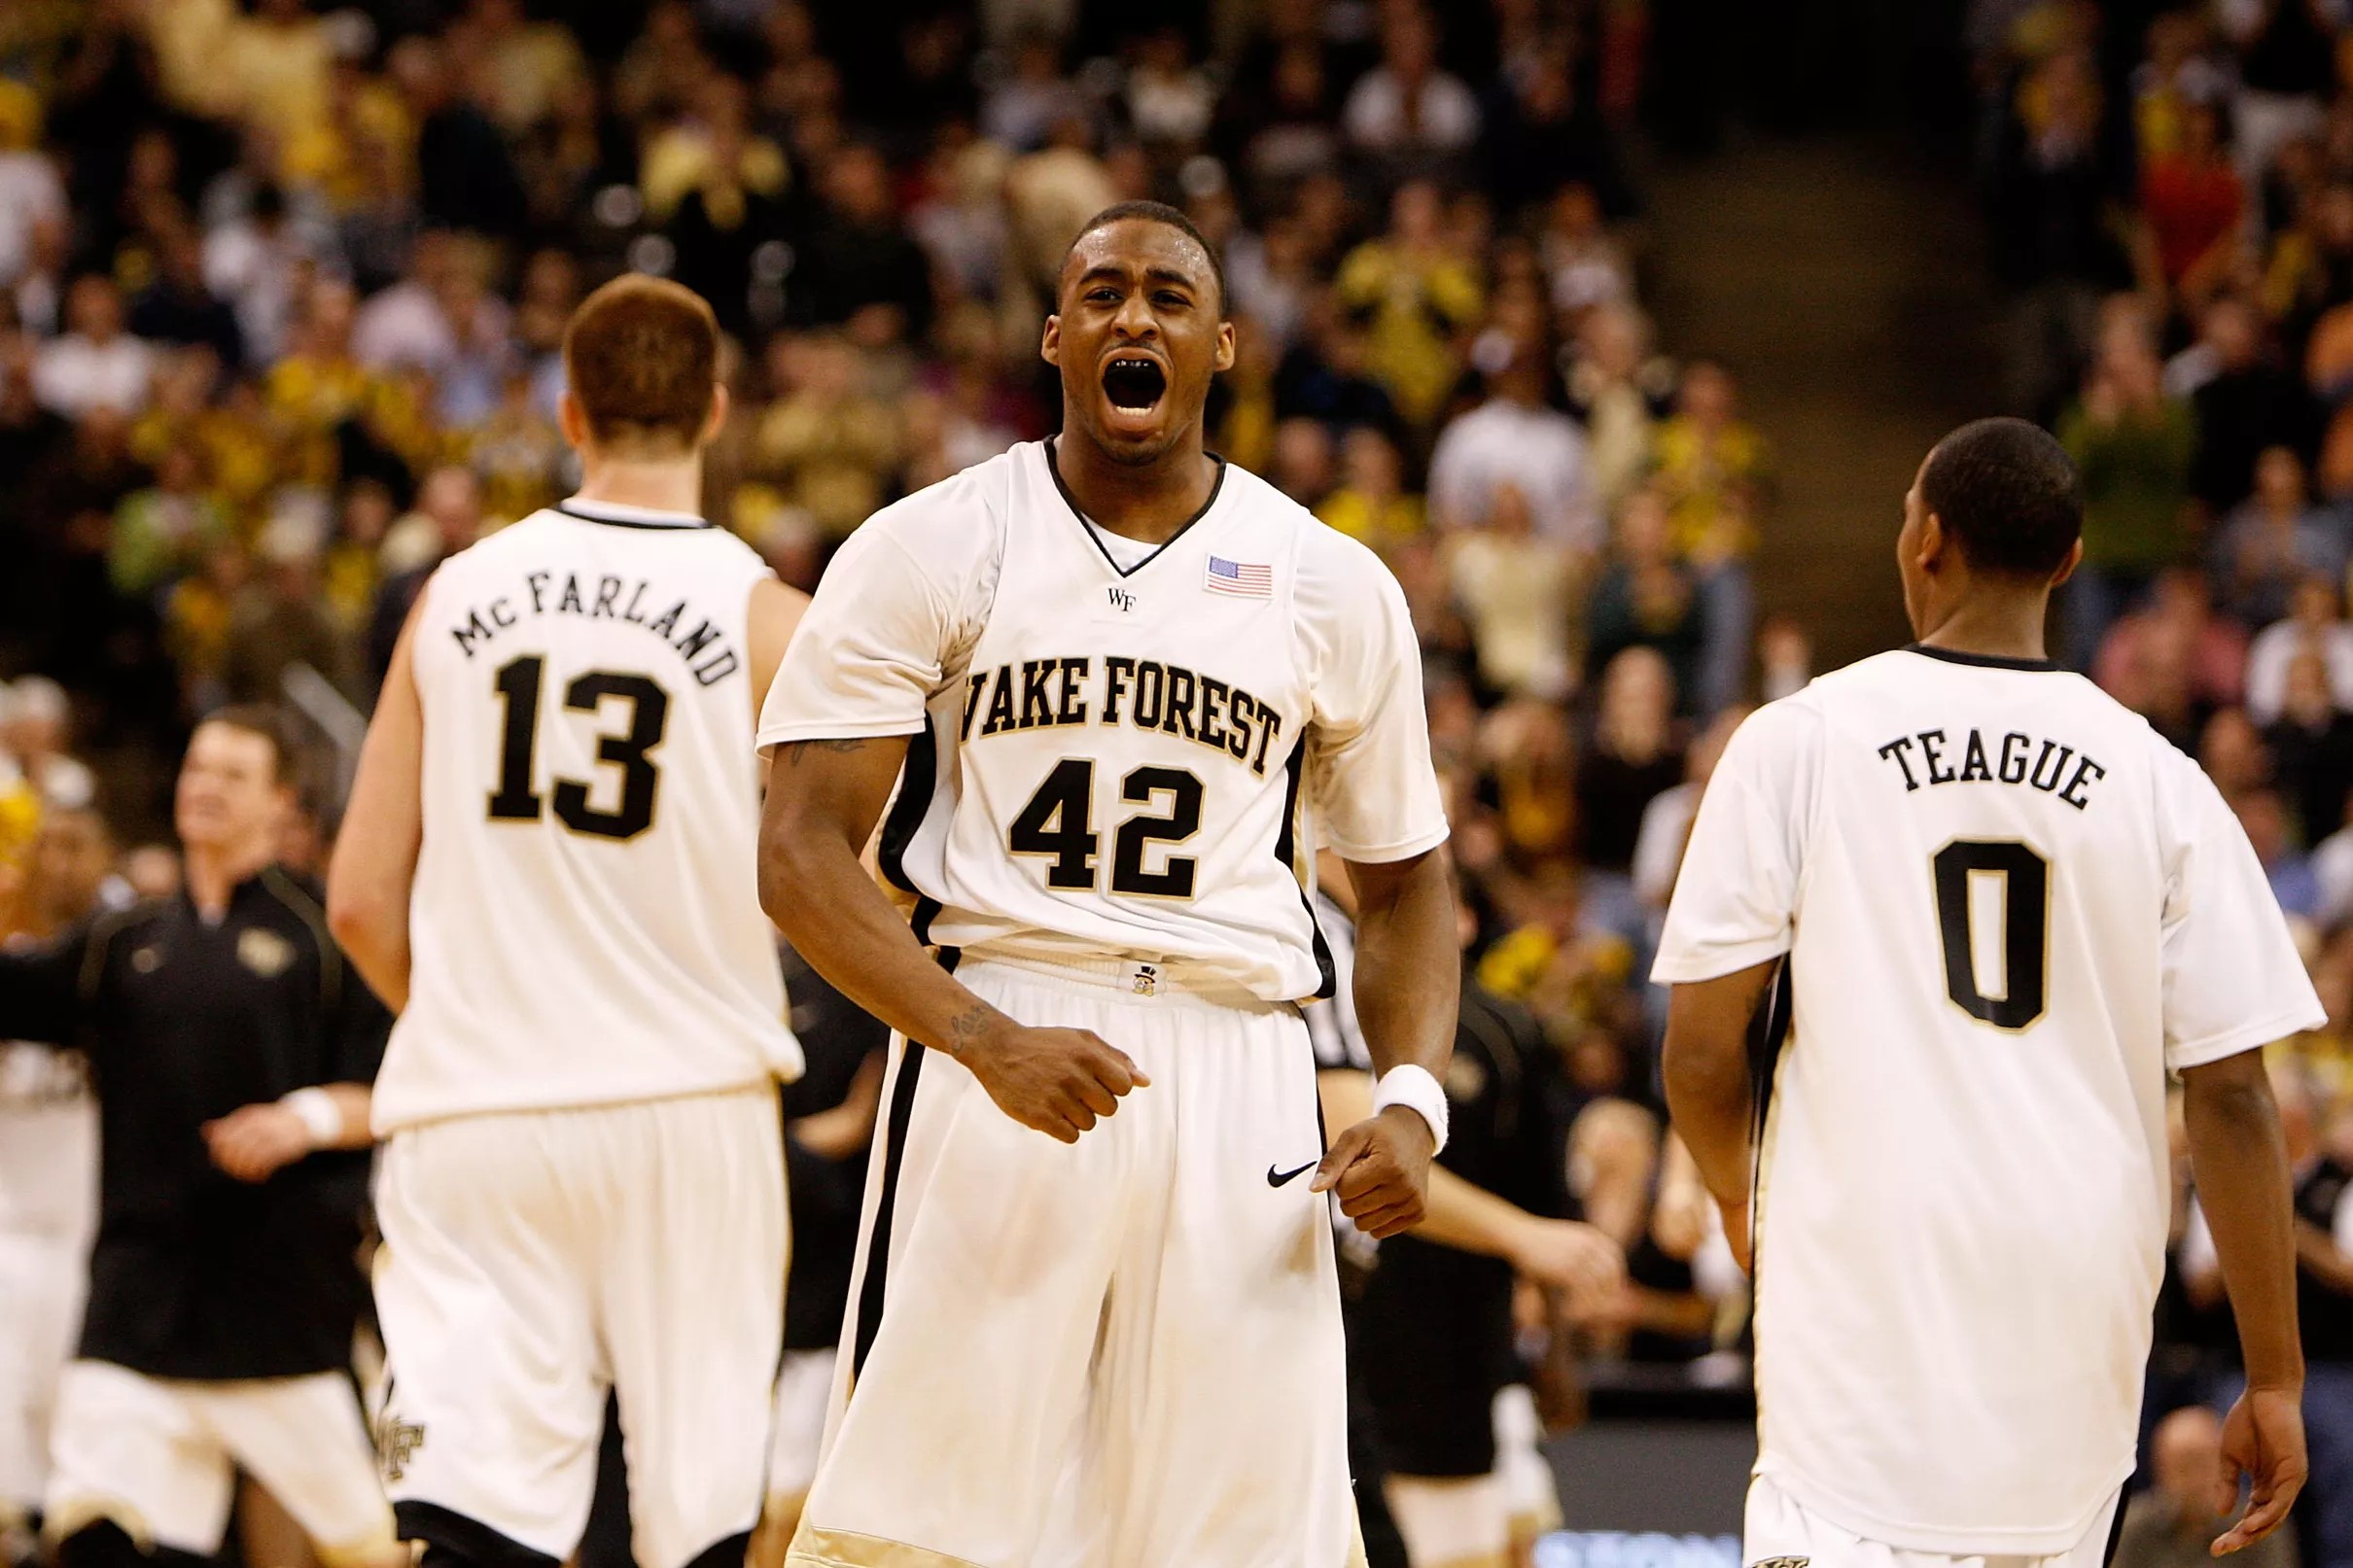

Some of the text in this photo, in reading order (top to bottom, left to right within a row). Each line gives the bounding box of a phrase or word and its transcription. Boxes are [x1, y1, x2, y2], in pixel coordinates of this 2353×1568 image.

[1108, 587, 1137, 612] WF
[486, 652, 671, 844] 13
[1100, 655, 1282, 778] FOREST
[1878, 727, 2106, 810] TEAGUE
[1006, 756, 1207, 902] 42
[1929, 834, 2053, 1034] 0
